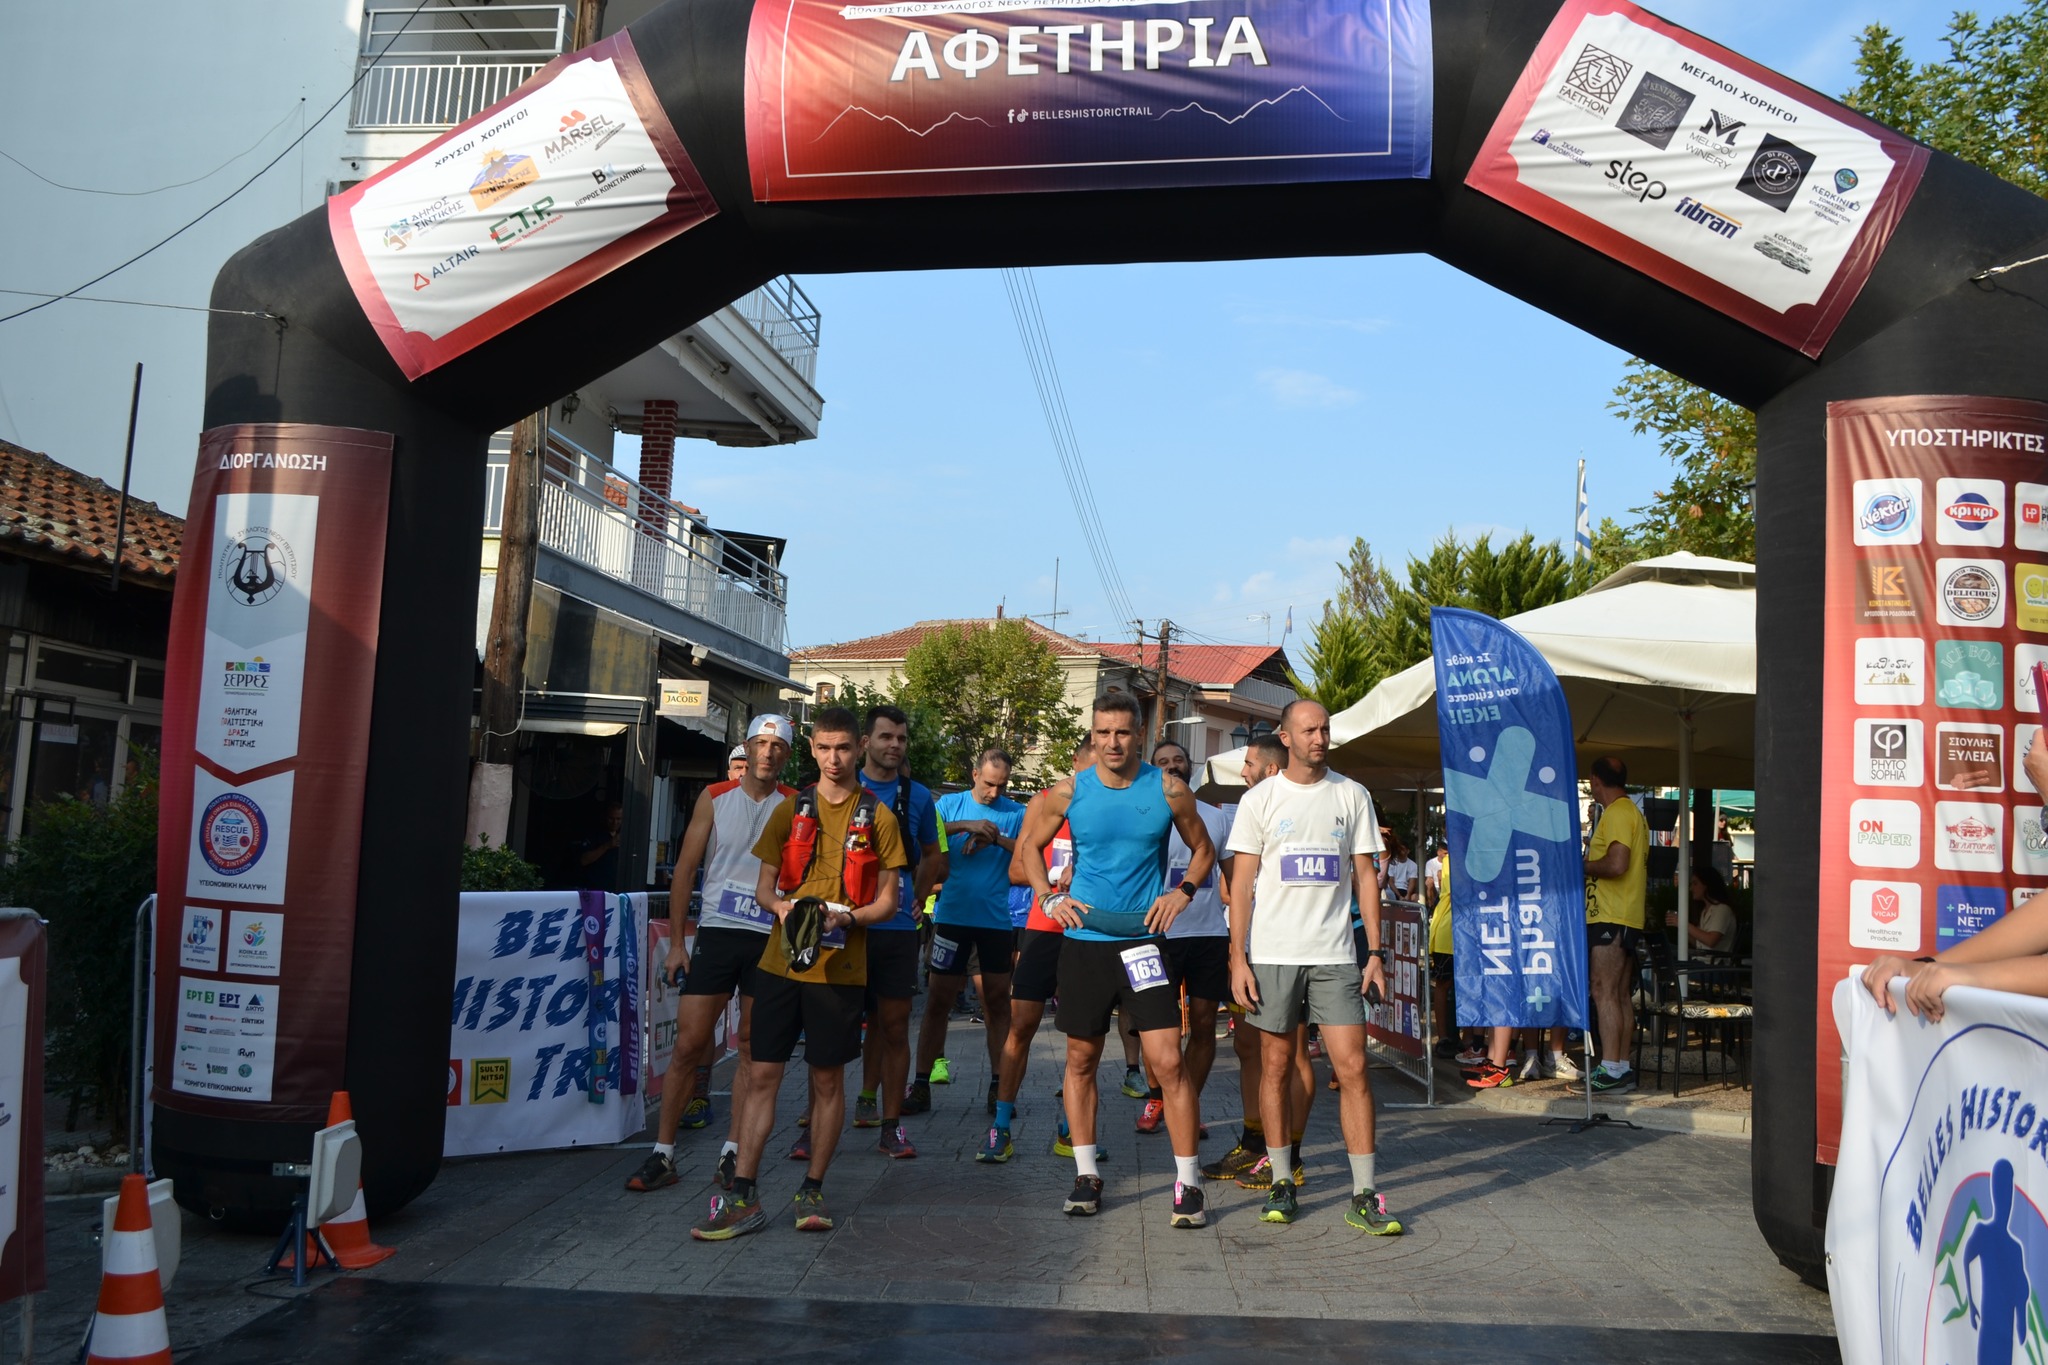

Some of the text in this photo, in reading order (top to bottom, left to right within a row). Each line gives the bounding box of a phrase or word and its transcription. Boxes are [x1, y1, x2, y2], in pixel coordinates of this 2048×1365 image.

[891, 16, 1268, 81] ΑΦΕΤΗΡΙΑ
[1681, 62, 1798, 124] ΜΕΓΑΛΟΙ ΧΟΡΗΓΟΙ
[1559, 86, 1609, 116] FAETHON
[1032, 107, 1153, 120] BELLESHISTORICTRAIL
[434, 108, 529, 168] ΧΡΥΣΟΙ ΧΟΡΗΓΟΙ
[1689, 131, 1738, 159] MELIDOU
[1684, 144, 1733, 170] WINERY
[1604, 159, 1667, 203] step
[1812, 184, 1850, 209] KERKINI
[411, 196, 450, 222] ΔΗΜΟΣ
[415, 200, 464, 231] ΣΙΝΤΙΚΗΣ
[1673, 196, 1739, 240] fibran
[1774, 232, 1808, 253] KORONIDIS
[432, 244, 480, 278] ALTAIR
[1886, 428, 2045, 453] ΥΠΟΣΤΗΡΙΚΤΕΣ
[219, 453, 327, 472] ΔΙΟΡΓΑΝΩΣΗ
[1947, 590, 1997, 598] DELICIOUS
[1940, 645, 2001, 669] ICE BOY
[223, 673, 270, 688] ΣΕΡΡΕΣ
[666, 694, 699, 704] JACOBS
[224, 707, 257, 716] ΑΘΛΗΤΙΚΗ
[228, 729, 249, 737] ΔΡΑΣΗ
[224, 739, 256, 748] ΣΙΝΤΙΚΗΣ
[1948, 737, 1995, 748] ΣΙΟΥΛΗΣ
[1948, 750, 1995, 763] ΞΥΛΕΙΑ
[1871, 760, 1907, 771] PHYTO
[1871, 769, 1906, 781] SOPHIA
[1335, 816, 1345, 827] N
[1859, 820, 1883, 833] ON
[215, 825, 249, 835] RESCUE
[1858, 832, 1912, 846] PAPER
[1294, 857, 1327, 876] 144
[199, 879, 267, 891] ΥΓΕΙΟΝΟΜΙΚΗ ΚΑΛΥΨΗ
[734, 896, 761, 918] 143
[1873, 910, 1897, 918] VICAN
[1957, 903, 1996, 917] Pharm
[1957, 916, 1984, 928] NET.
[1867, 928, 1902, 936] Healthcare
[1870, 935, 1899, 943] Products
[1129, 957, 1162, 982] 163
[219, 993, 241, 1004] ΕΡΤ
[479, 1065, 504, 1073] SULTA
[480, 1073, 504, 1082] NITSA
[184, 1079, 253, 1093] ΧΟΡΗΓΟΙ ΕΠΙΚΟΙΝΩΝΙΑΣ
[1906, 1104, 1953, 1254] BELLES
